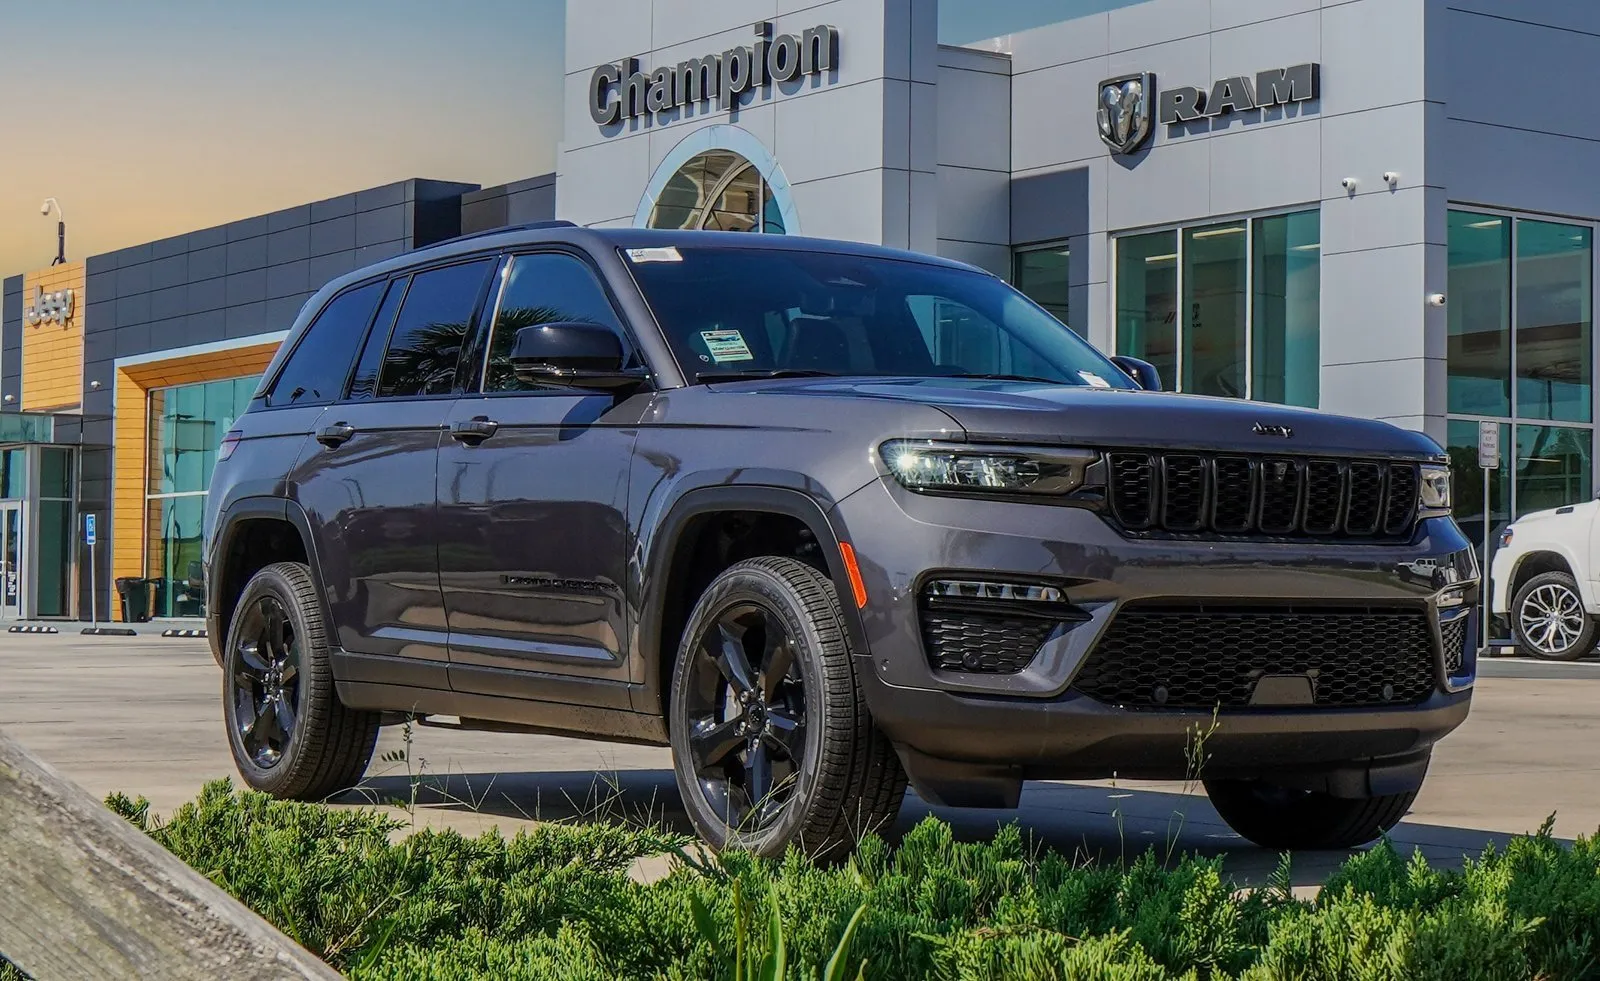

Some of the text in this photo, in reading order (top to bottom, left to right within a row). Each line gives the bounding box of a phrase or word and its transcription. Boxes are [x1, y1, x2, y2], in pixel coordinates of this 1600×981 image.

[589, 21, 839, 126] Champion
[1159, 63, 1320, 124] RAM
[28, 284, 75, 327] Jeep
